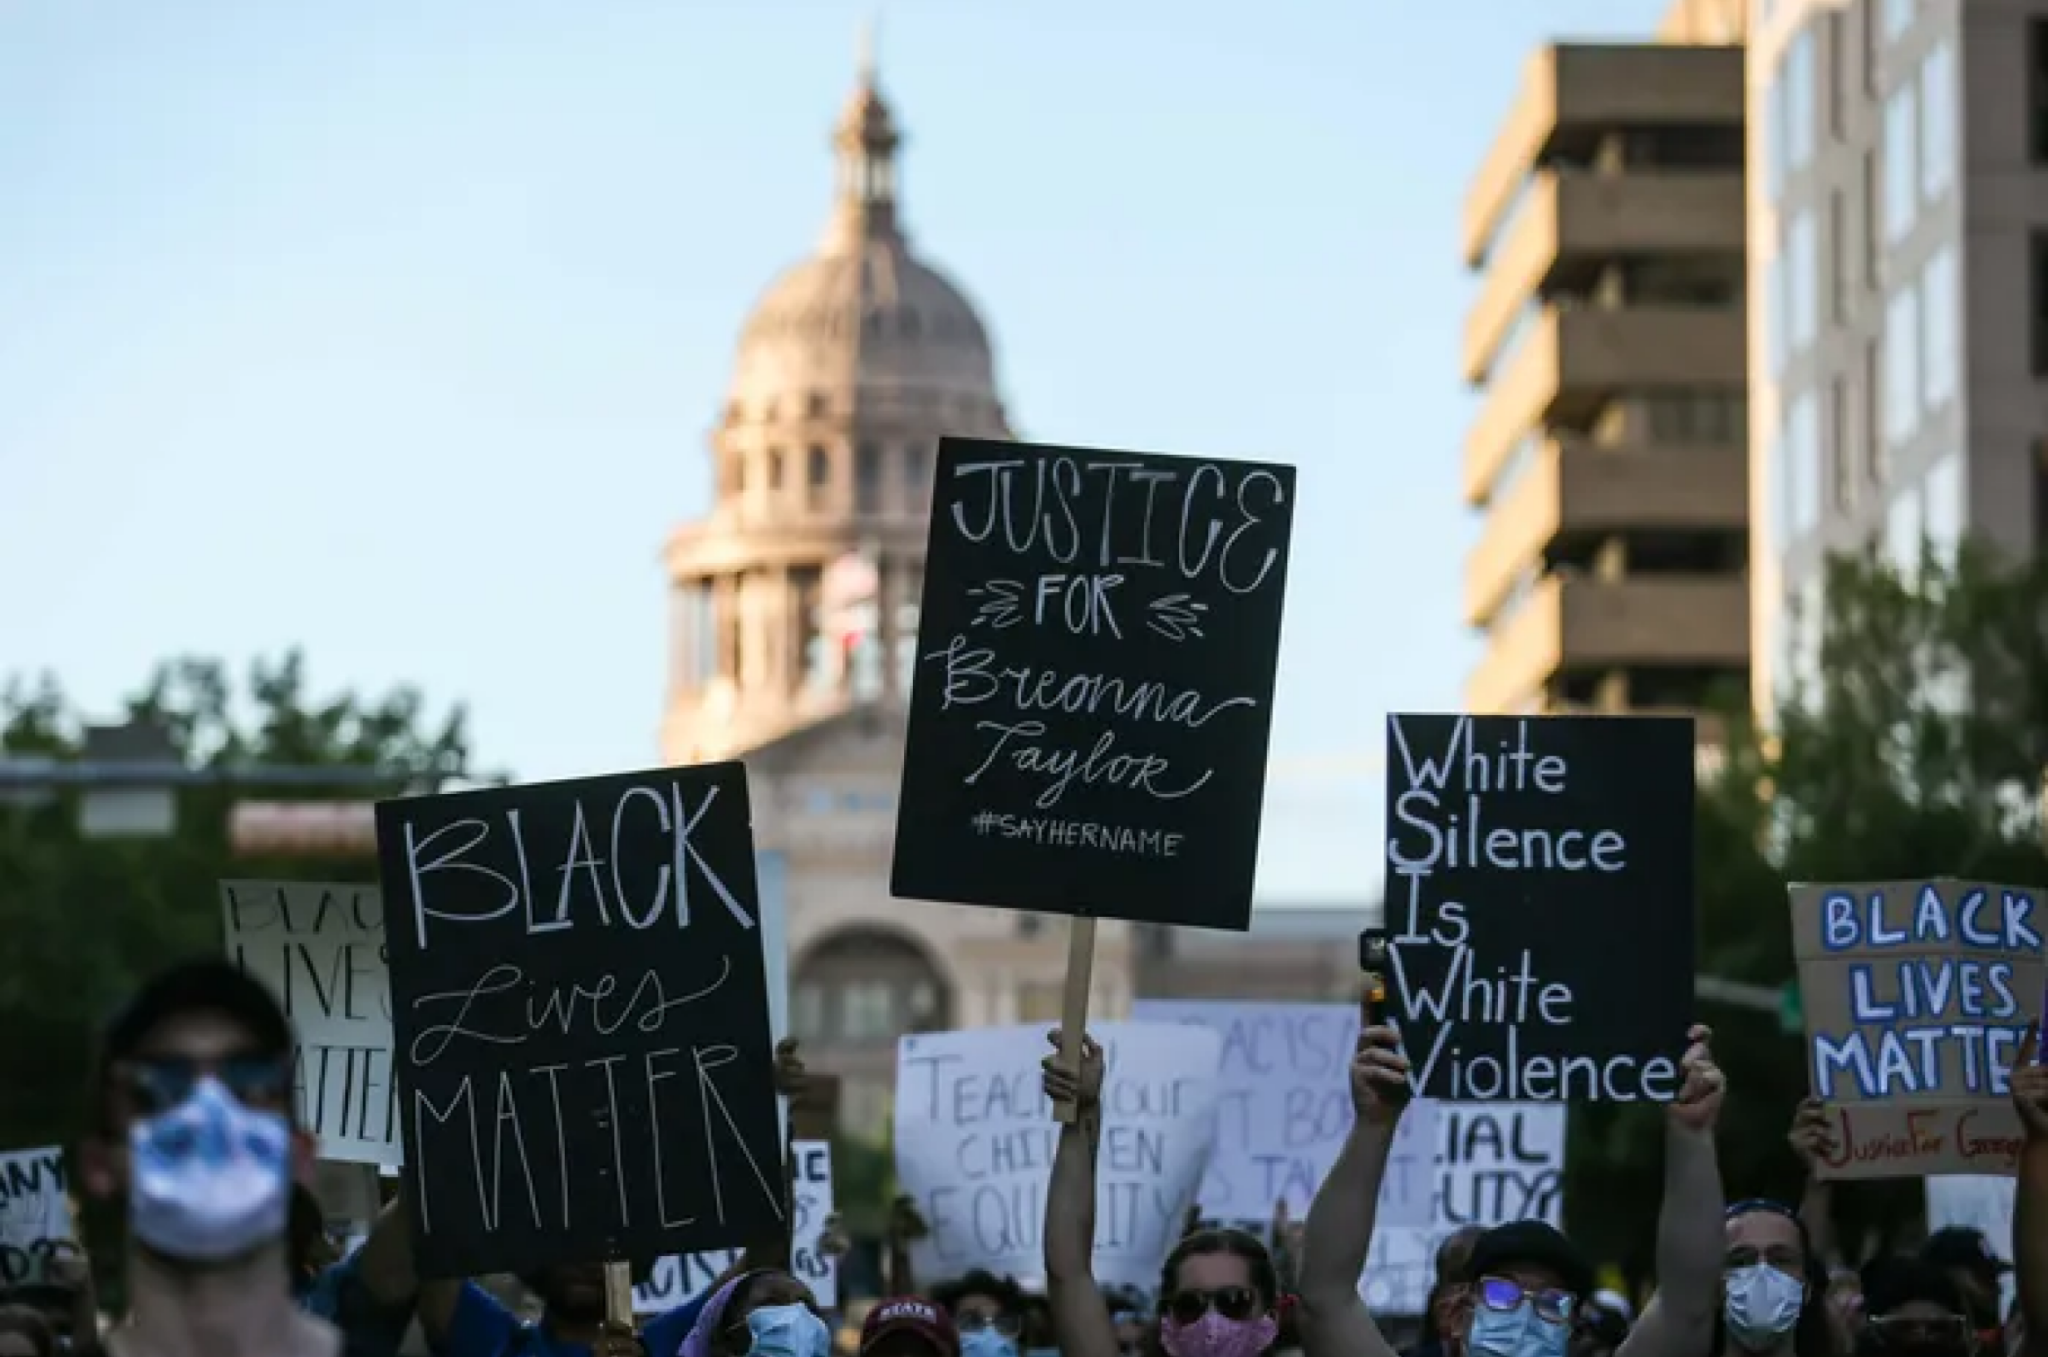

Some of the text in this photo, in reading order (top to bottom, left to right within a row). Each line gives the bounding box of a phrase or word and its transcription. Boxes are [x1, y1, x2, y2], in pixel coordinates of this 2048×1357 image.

[950, 457, 1285, 593] JUSTICE
[1034, 573, 1125, 640] FOR
[924, 635, 1256, 728] Breonna
[1389, 713, 1568, 794] White
[404, 781, 755, 949] BLACK
[971, 811, 1185, 857] #SAYHERNAME
[1387, 788, 1628, 871] Silence
[227, 885, 384, 934] BLAC
[1393, 863, 1471, 947] Is
[1823, 882, 2043, 953] BLACK
[410, 954, 730, 1065] Lives
[1386, 942, 1574, 1025] White
[1848, 960, 2018, 1023] LIVES
[1218, 1013, 1353, 1073] ACIS
[1386, 1016, 1676, 1102] Violence
[1813, 1022, 2041, 1099] MATTE
[413, 1044, 785, 1233] MATTER
[1434, 1112, 1550, 1165] IAL
[1430, 1167, 1564, 1223] LITY?
